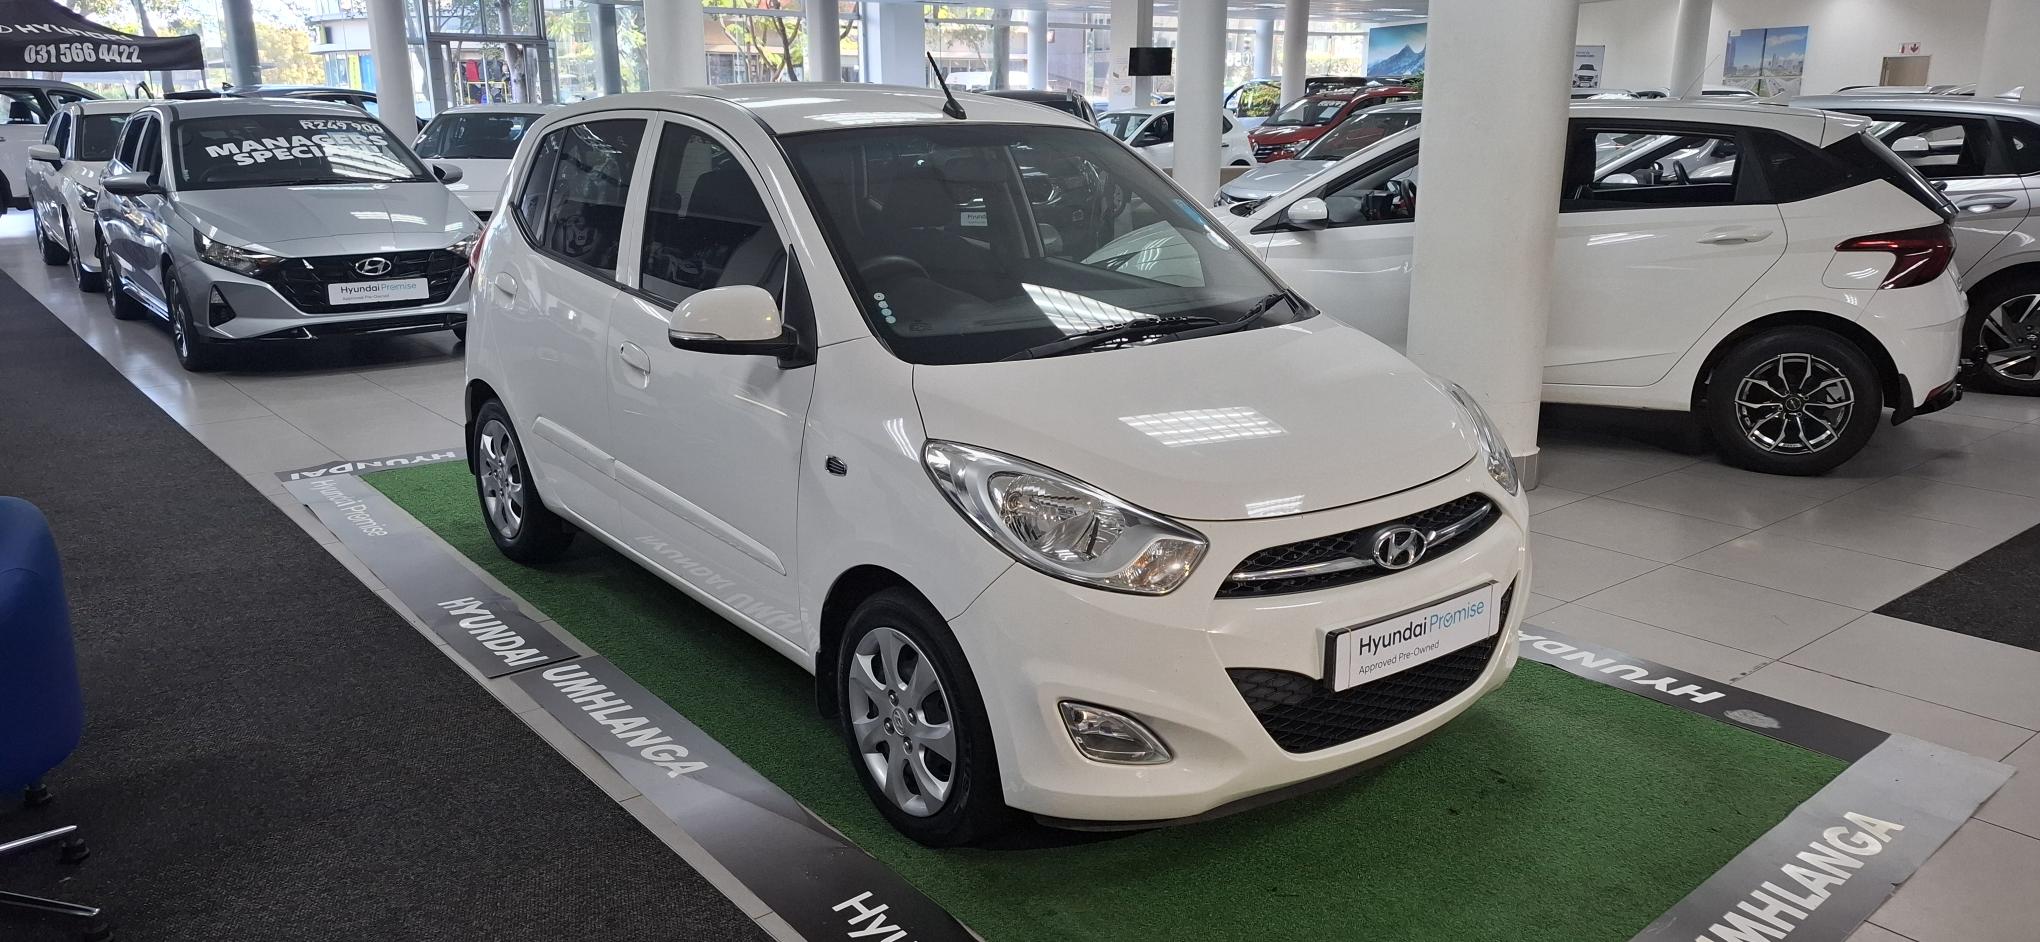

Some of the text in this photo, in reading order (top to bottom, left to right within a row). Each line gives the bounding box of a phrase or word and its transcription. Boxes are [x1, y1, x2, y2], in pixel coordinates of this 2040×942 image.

[15, 23, 134, 42] HYUNDAI
[24, 42, 142, 64] 031 566 4422
[204, 134, 388, 158] MANAGERS
[340, 283, 417, 295] Hyundai Promise
[290, 451, 456, 480] HYUNDAI
[346, 499, 388, 537] Promise
[437, 596, 549, 667] HYUNDAI
[1359, 600, 1485, 656] Hyundai Promise
[1358, 640, 1440, 676] Approved Pre-Owned
[1518, 630, 1726, 704] HYUNDA
[542, 664, 709, 778] UMHLANGA
[1696, 811, 1905, 942] MHLANGA
